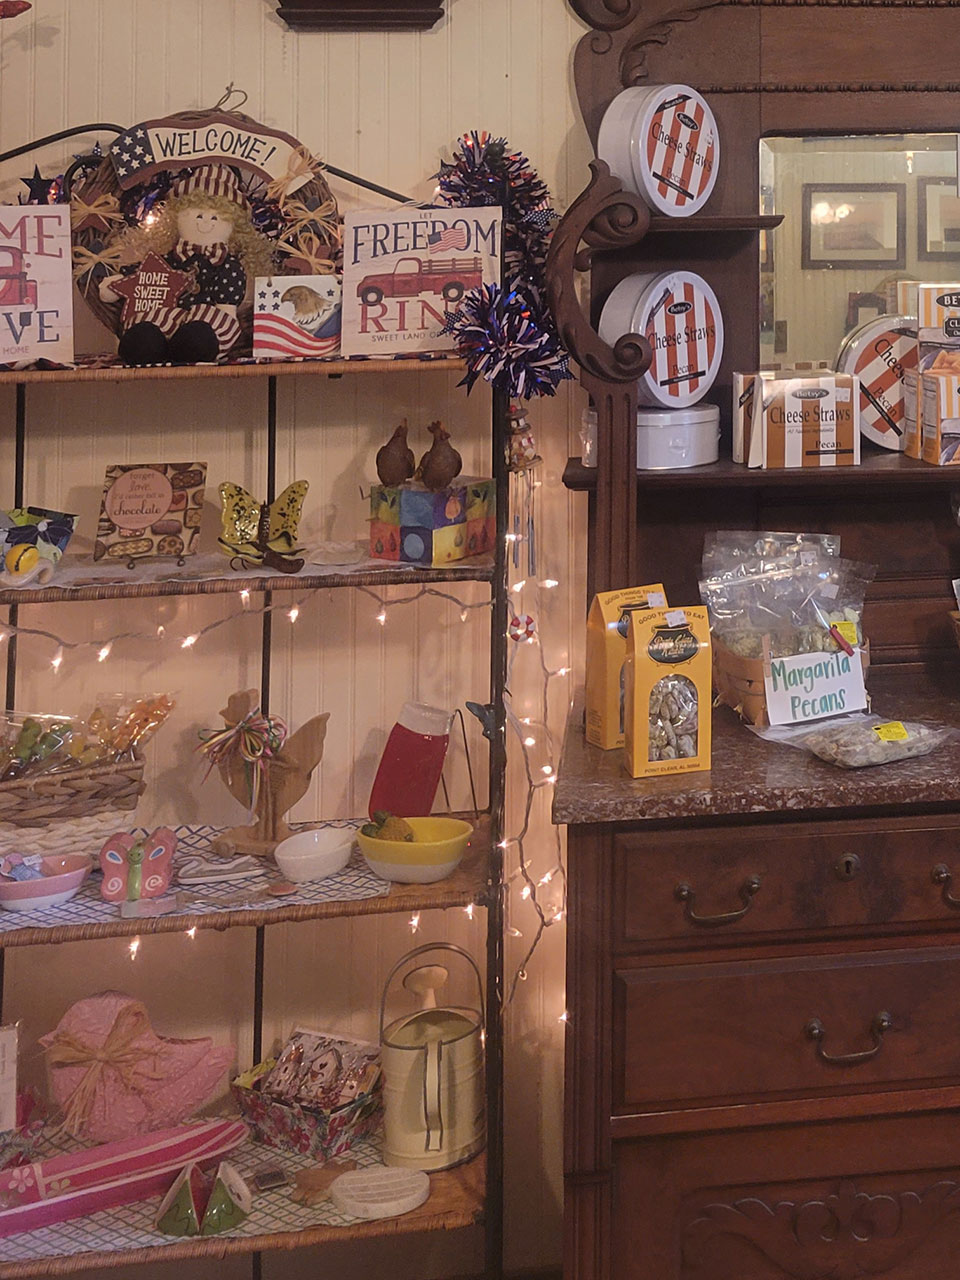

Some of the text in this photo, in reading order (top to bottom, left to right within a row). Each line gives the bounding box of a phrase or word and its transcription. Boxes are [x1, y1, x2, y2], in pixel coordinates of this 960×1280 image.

[155, 128, 277, 166] WELCOME!
[652, 122, 712, 172] Cheese Straws
[138, 271, 169, 285] HOME
[134, 286, 170, 299] SWEET
[358, 297, 466, 333] RIN
[371, 332, 426, 342] SWEET LAND
[648, 324, 715, 351] Cheese Straws
[3, 346, 30, 355] HOME
[873, 387, 897, 417] Pecan
[770, 406, 810, 424] Cheese
[813, 406, 850, 422] Straws
[816, 440, 842, 448] Pecan
[114, 500, 160, 516] chocolate
[638, 614, 657, 624] GOOD
[790, 688, 846, 720] Pecans
